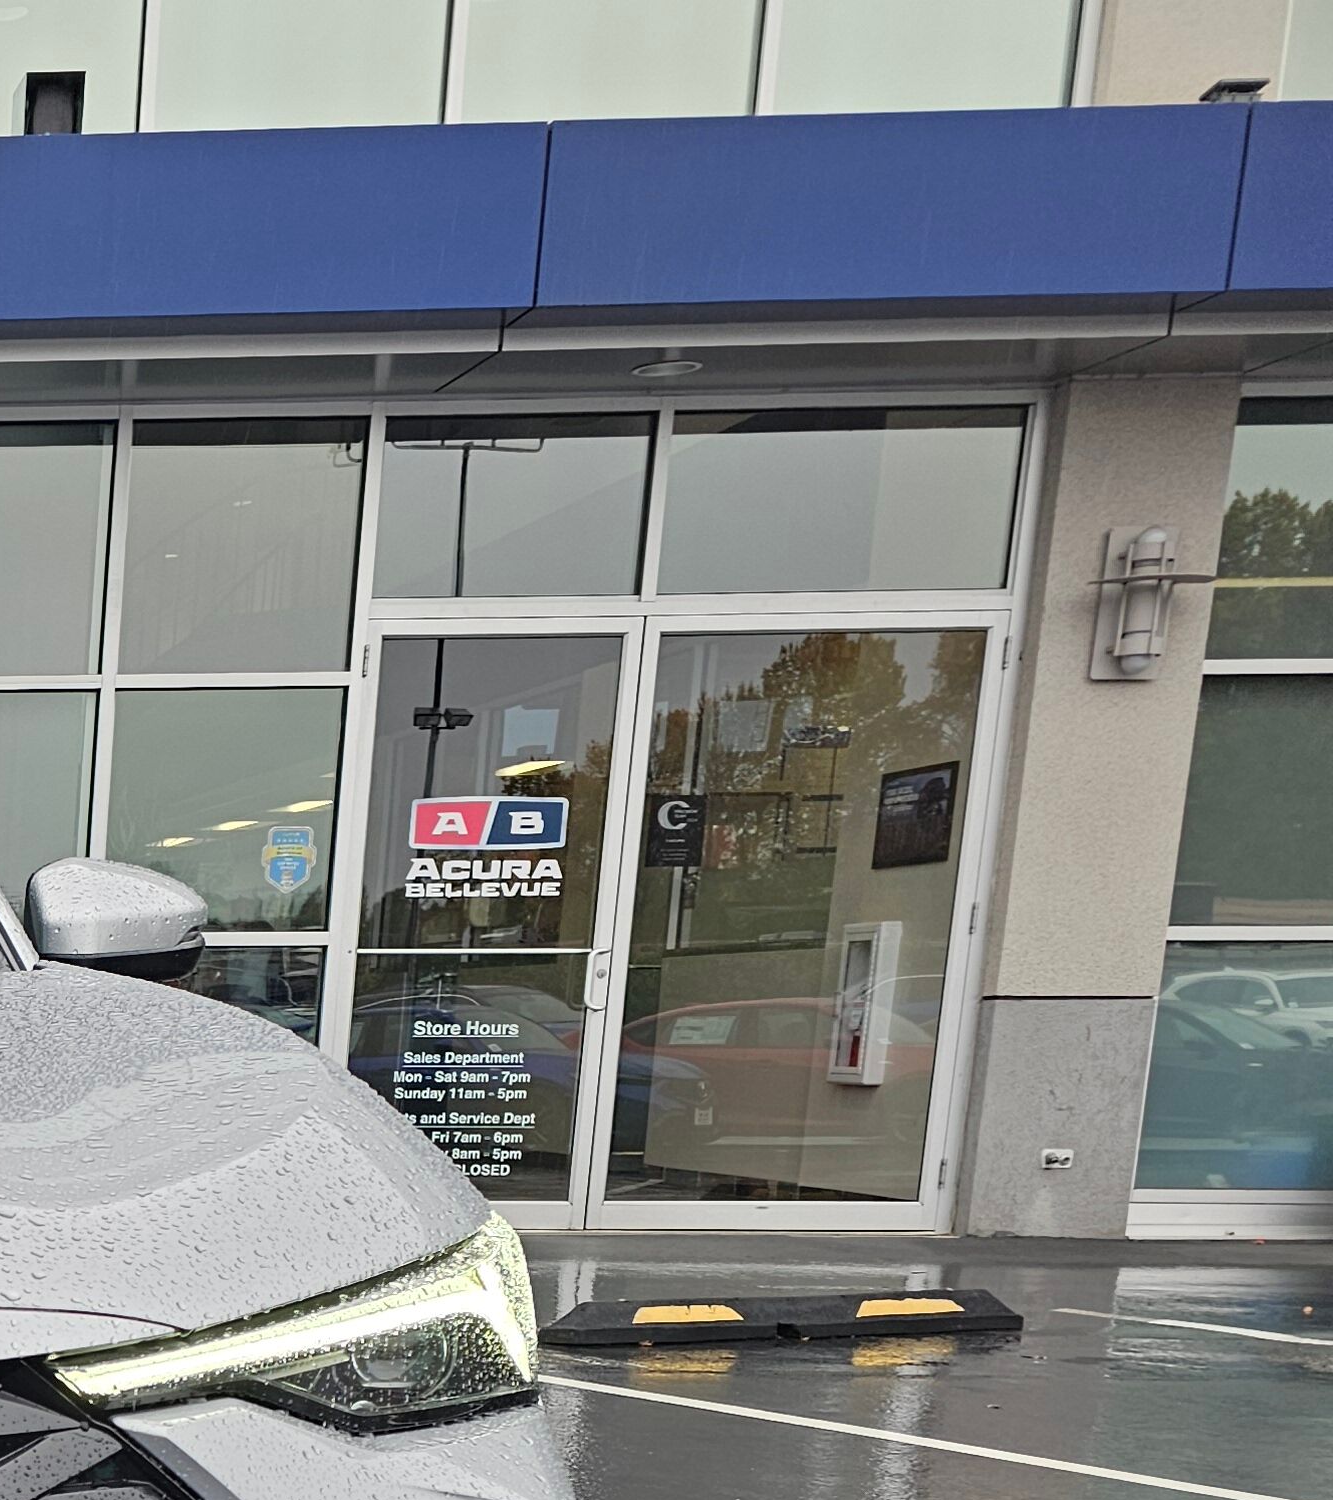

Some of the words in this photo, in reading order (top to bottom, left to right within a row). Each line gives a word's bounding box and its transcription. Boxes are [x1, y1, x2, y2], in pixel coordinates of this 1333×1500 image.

[431, 812, 469, 835] A
[508, 811, 545, 834] B
[405, 857, 563, 880] ACURA
[404, 881, 561, 898] BELLEVUE
[413, 1020, 462, 1036] Store
[466, 1021, 520, 1036] Hours
[403, 1052, 441, 1064] Sales
[444, 1052, 525, 1066] Department
[393, 1071, 423, 1083] Mon
[434, 1071, 457, 1083] Sat
[460, 1071, 489, 1083] 9am
[501, 1071, 531, 1086] 7pm
[394, 1088, 445, 1102] Sunday
[449, 1088, 485, 1100] 11am
[497, 1088, 527, 1103] 5pm
[420, 1113, 446, 1124] and
[449, 1113, 500, 1124] Service
[503, 1113, 535, 1126] Dept
[432, 1132, 450, 1143] Fri
[453, 1132, 482, 1143] 7am
[493, 1132, 524, 1146] 6pm
[452, 1149, 480, 1160] 8am
[492, 1149, 522, 1162] 5pm
[454, 1164, 510, 1176] LOSED
